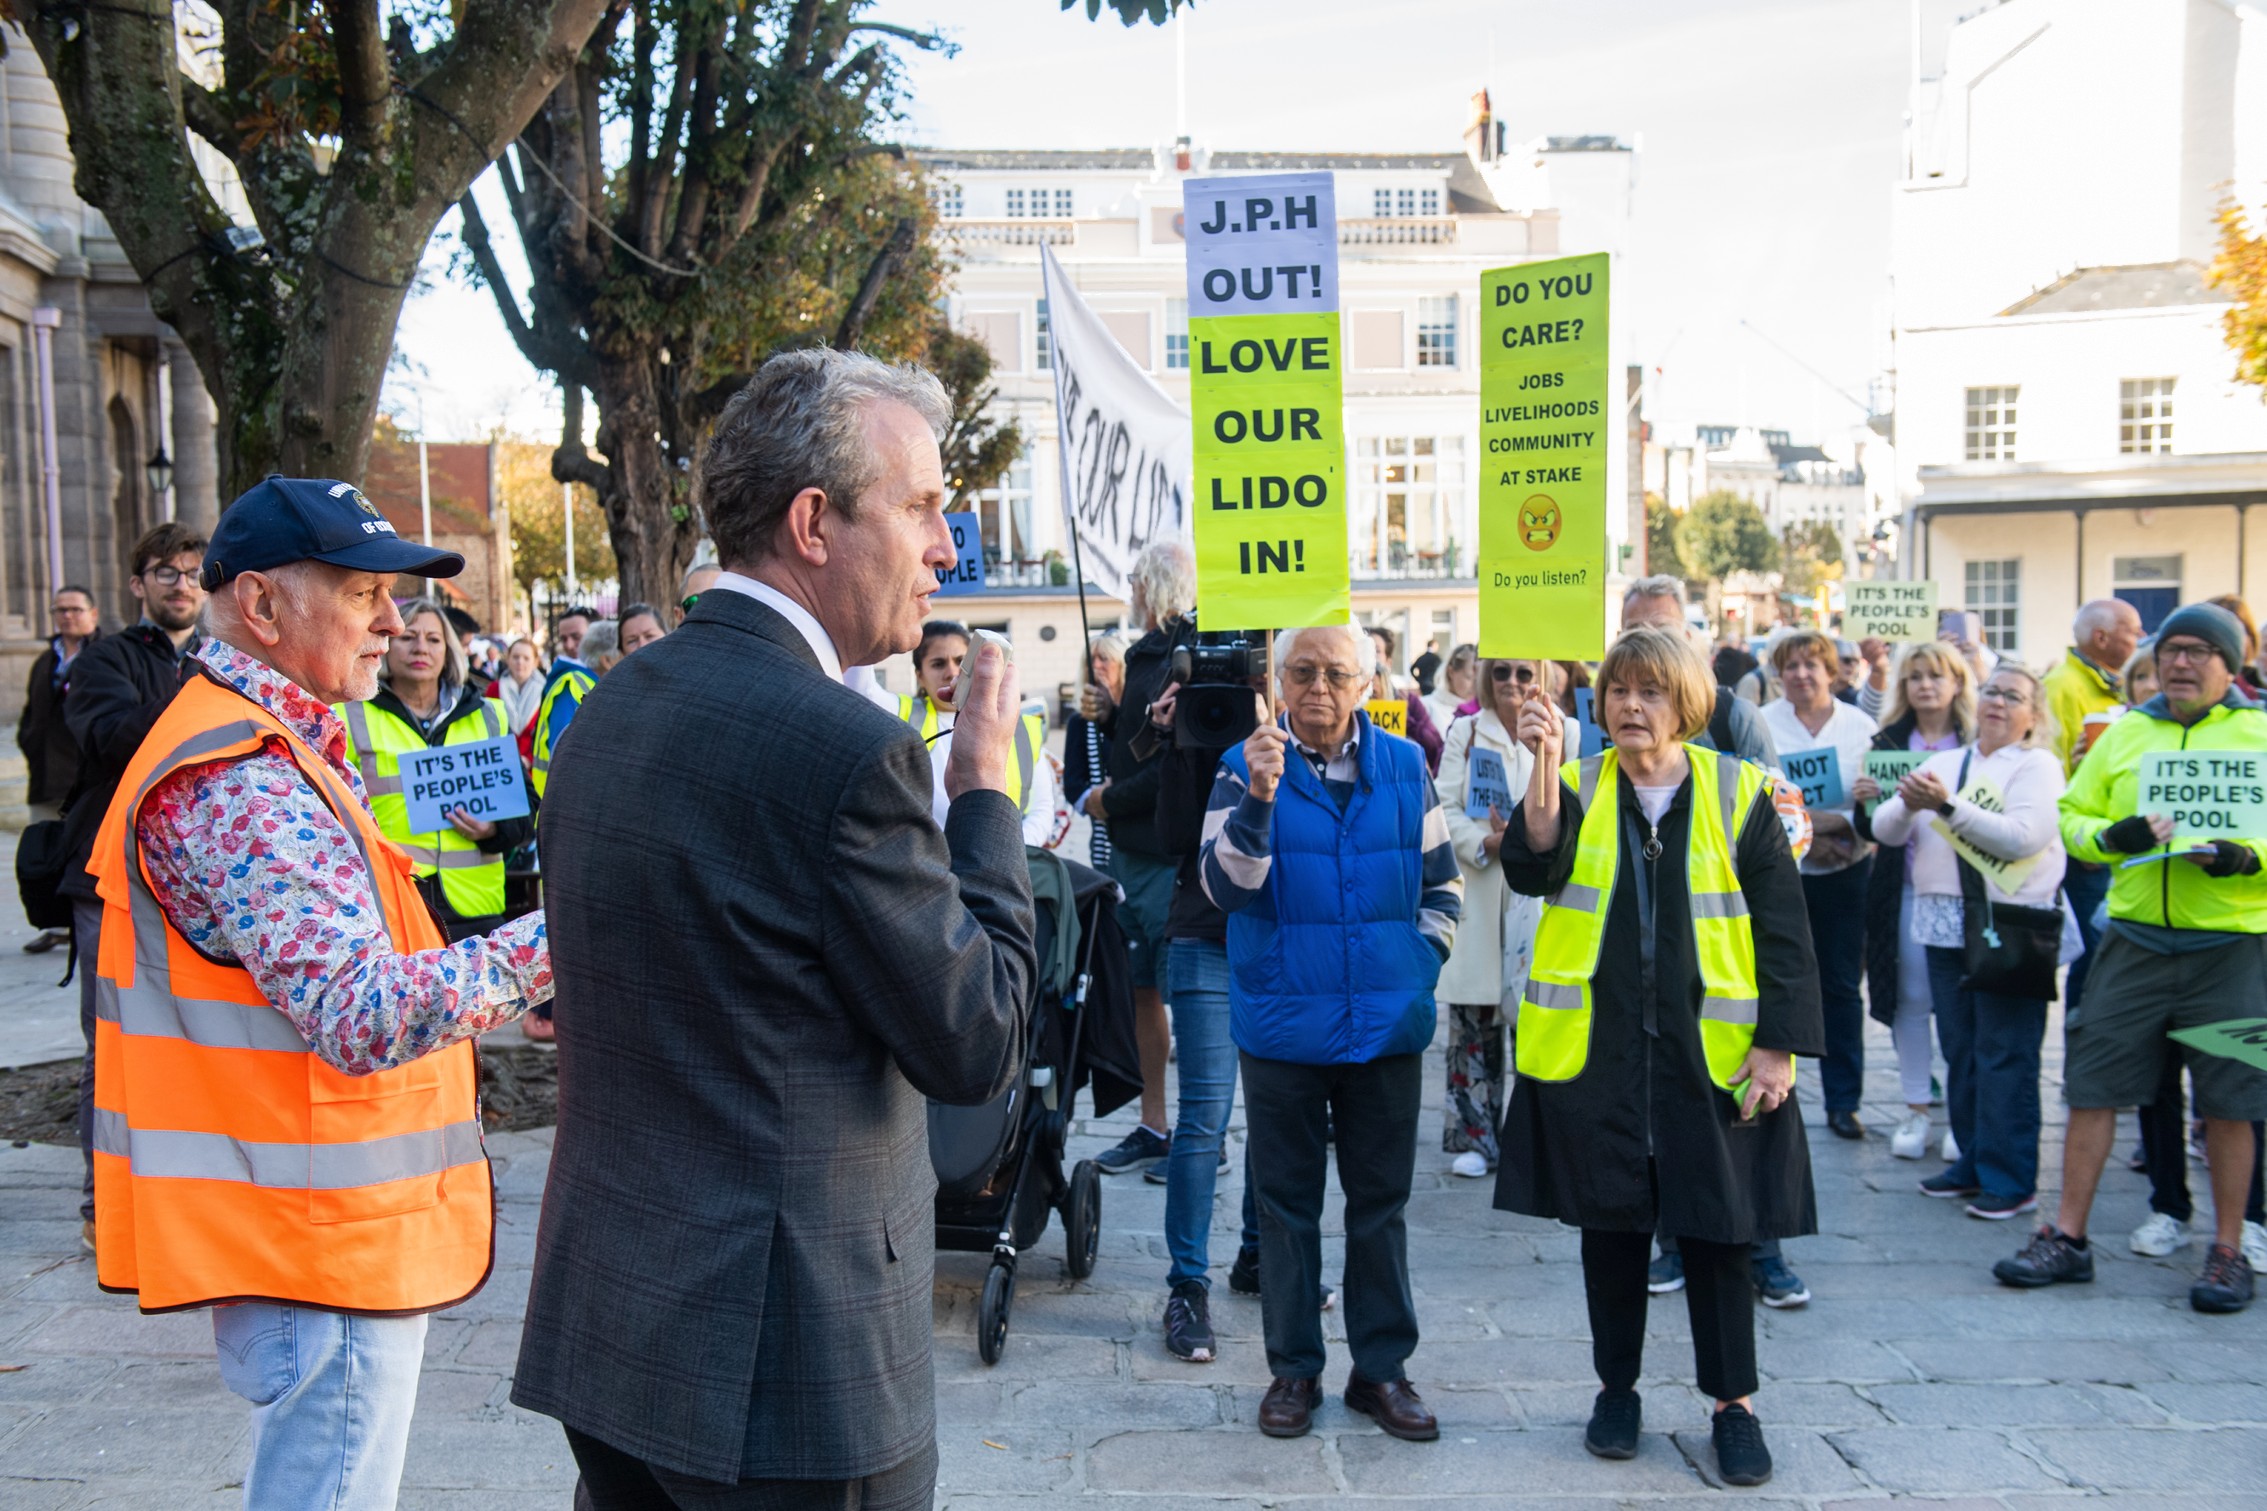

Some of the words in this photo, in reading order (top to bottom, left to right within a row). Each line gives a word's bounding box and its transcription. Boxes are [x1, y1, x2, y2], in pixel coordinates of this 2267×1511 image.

[1200, 195, 1317, 234] J.P.H
[1203, 265, 1321, 302] OUT!
[1496, 282, 1530, 307] DO
[1538, 272, 1592, 300] YOU
[1502, 319, 1584, 349] CARE?
[1519, 372, 1564, 390] JOBS
[1485, 400, 1599, 423] LIVELIHOODS
[1214, 408, 1323, 443] OUR
[1489, 432, 1595, 453] COMMUNITY
[1500, 471, 1520, 486] AT
[1526, 467, 1582, 484] STAKE
[361, 522, 377, 534] OF
[1240, 539, 1304, 574] IN!
[1494, 572, 1511, 587] Do
[1515, 575, 1538, 590] you
[1542, 569, 1587, 586] listen?
[1856, 587, 1887, 600] IT'S
[1893, 587, 1925, 600] THE
[1850, 605, 1930, 617] PEOPLE'S
[1867, 622, 1911, 635] POOL
[1367, 711, 1401, 729] ACK
[415, 755, 454, 777] IT'S
[460, 747, 503, 768] THE
[1788, 755, 1828, 780] NOT
[2157, 760, 2200, 777] IT'S
[2208, 760, 2257, 778] THE
[413, 768, 513, 801] PEOPLE'S
[2149, 785, 2264, 804] PEOPLE'S
[440, 796, 497, 820] POOL
[2174, 810, 2239, 828] POOL
